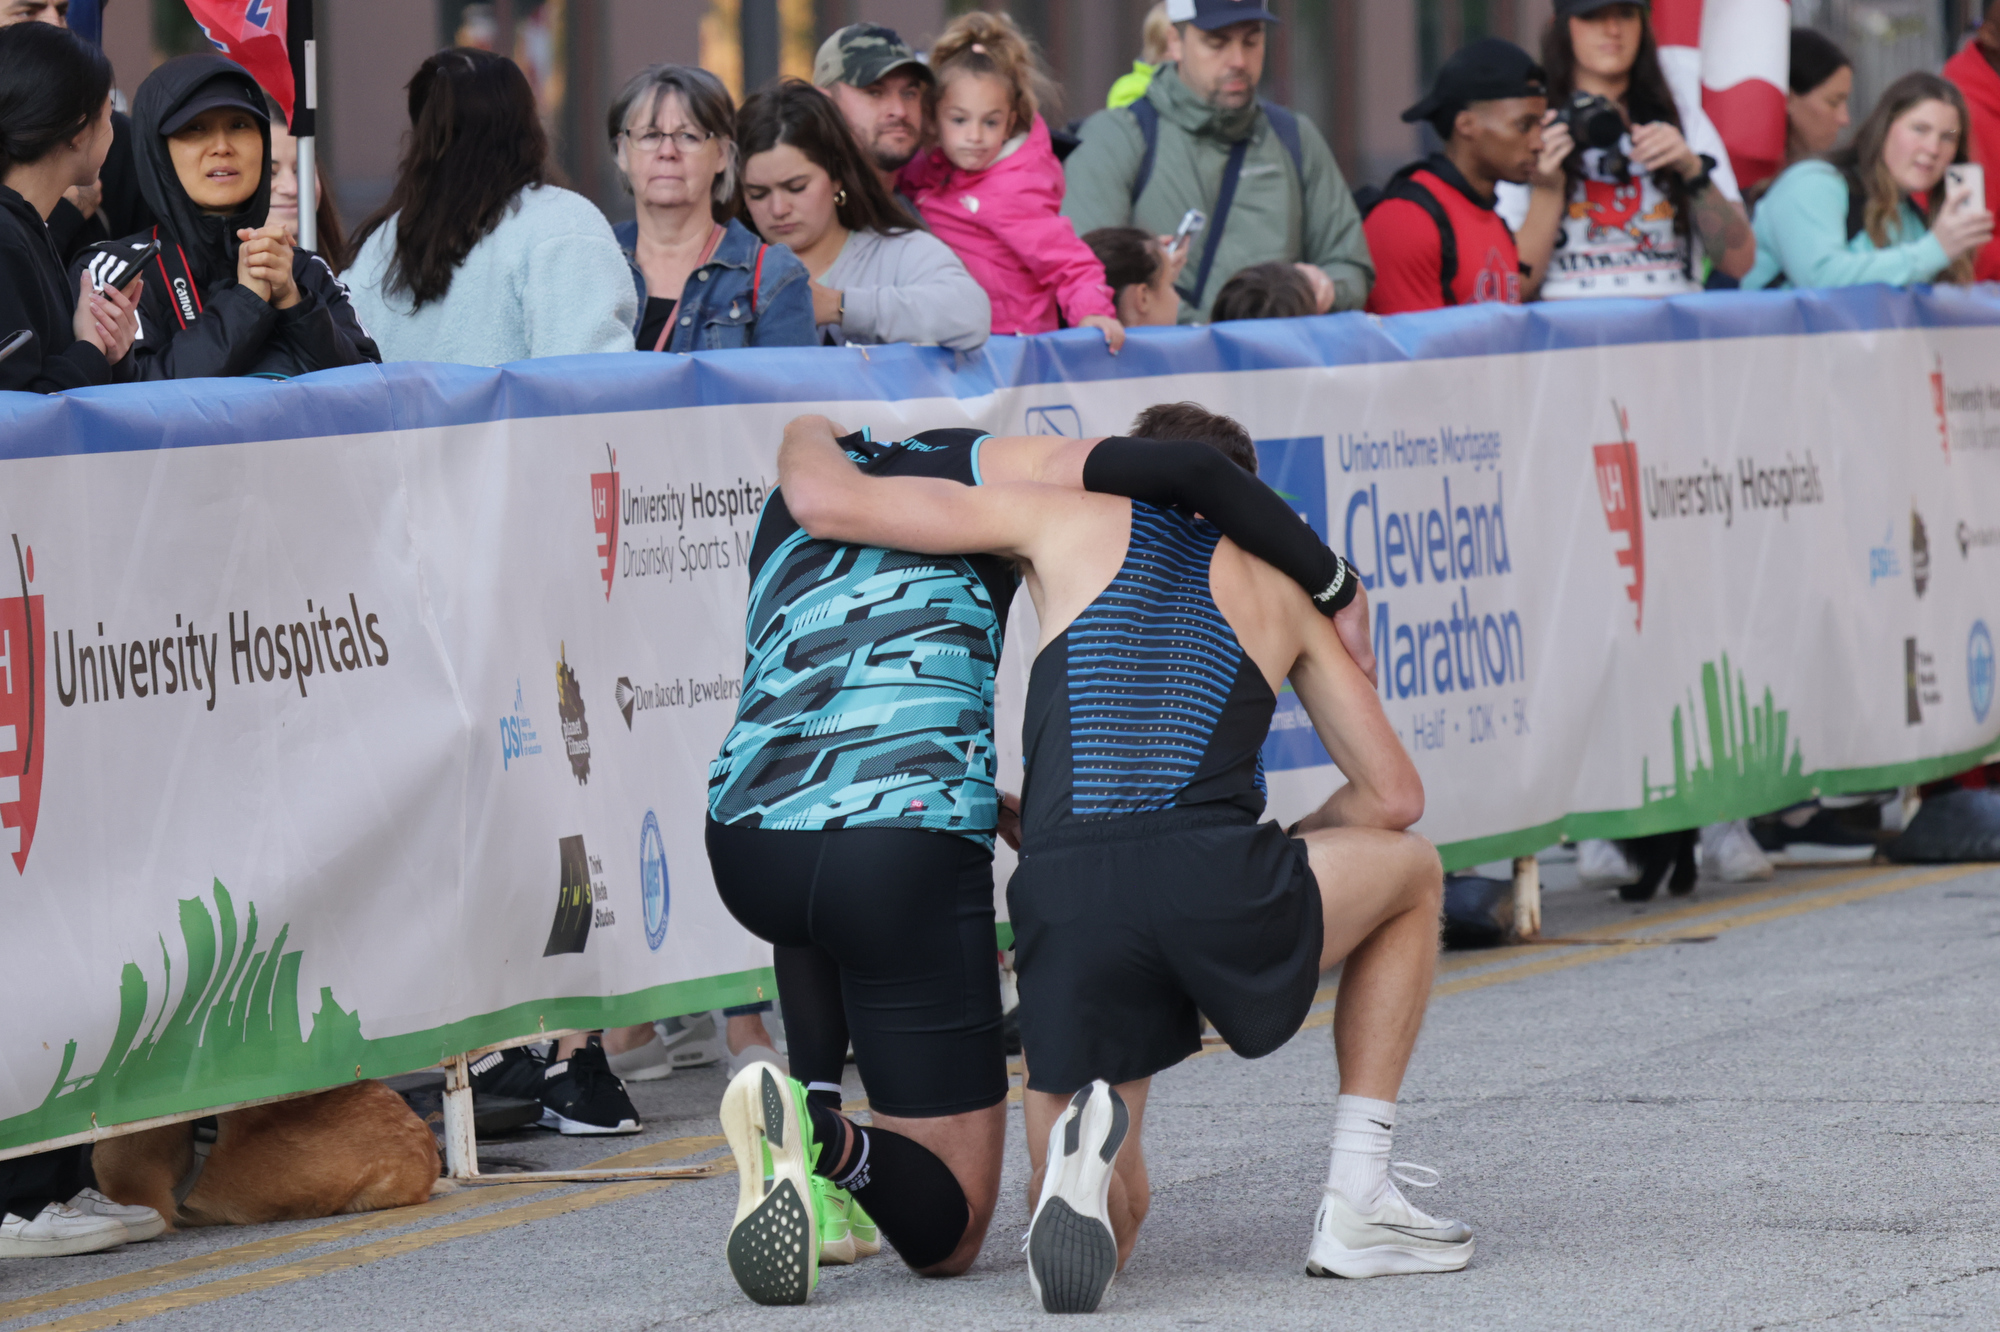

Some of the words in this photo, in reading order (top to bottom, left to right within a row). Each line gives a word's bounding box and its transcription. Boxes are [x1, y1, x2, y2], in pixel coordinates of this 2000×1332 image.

[174, 278, 196, 320] Canon
[1338, 430, 1391, 473] Union
[1393, 429, 1437, 468] Home
[593, 487, 606, 519] UH
[622, 484, 685, 531] University
[1643, 458, 1732, 528] University
[1737, 449, 1824, 522] Hospitals
[1345, 471, 1511, 591] Cleveland
[623, 538, 674, 584] Drusinsky
[678, 535, 730, 582] Sports
[53, 613, 217, 711] University
[229, 593, 389, 698] Hospitals
[635, 685, 654, 711] Don
[655, 678, 685, 708] Basch
[688, 674, 741, 709] Jewelers
[562, 717, 582, 742] planet
[1412, 708, 1445, 751] Half
[1467, 703, 1497, 743] 10K
[1513, 697, 1531, 736] 5K
[589, 854, 604, 876] Think
[469, 1051, 504, 1077] PUMA
